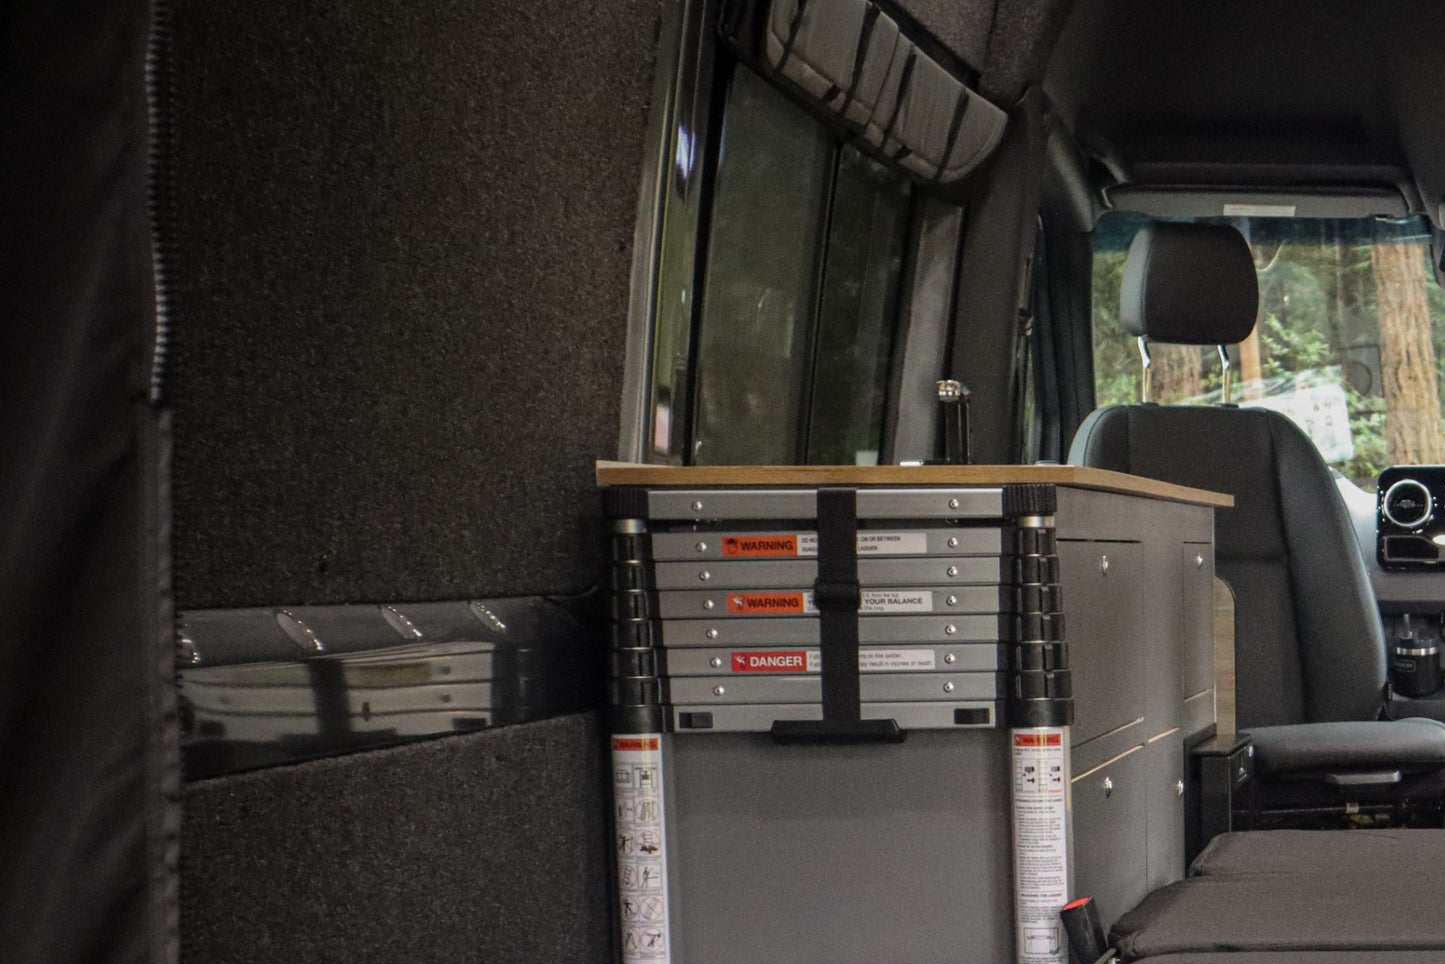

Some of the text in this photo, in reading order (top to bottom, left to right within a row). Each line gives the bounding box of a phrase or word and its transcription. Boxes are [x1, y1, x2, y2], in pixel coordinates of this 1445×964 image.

[740, 540, 793, 551] WARNING
[747, 597, 799, 608] WARNING
[887, 597, 923, 605] BALANCE
[749, 656, 803, 667] DANGER
